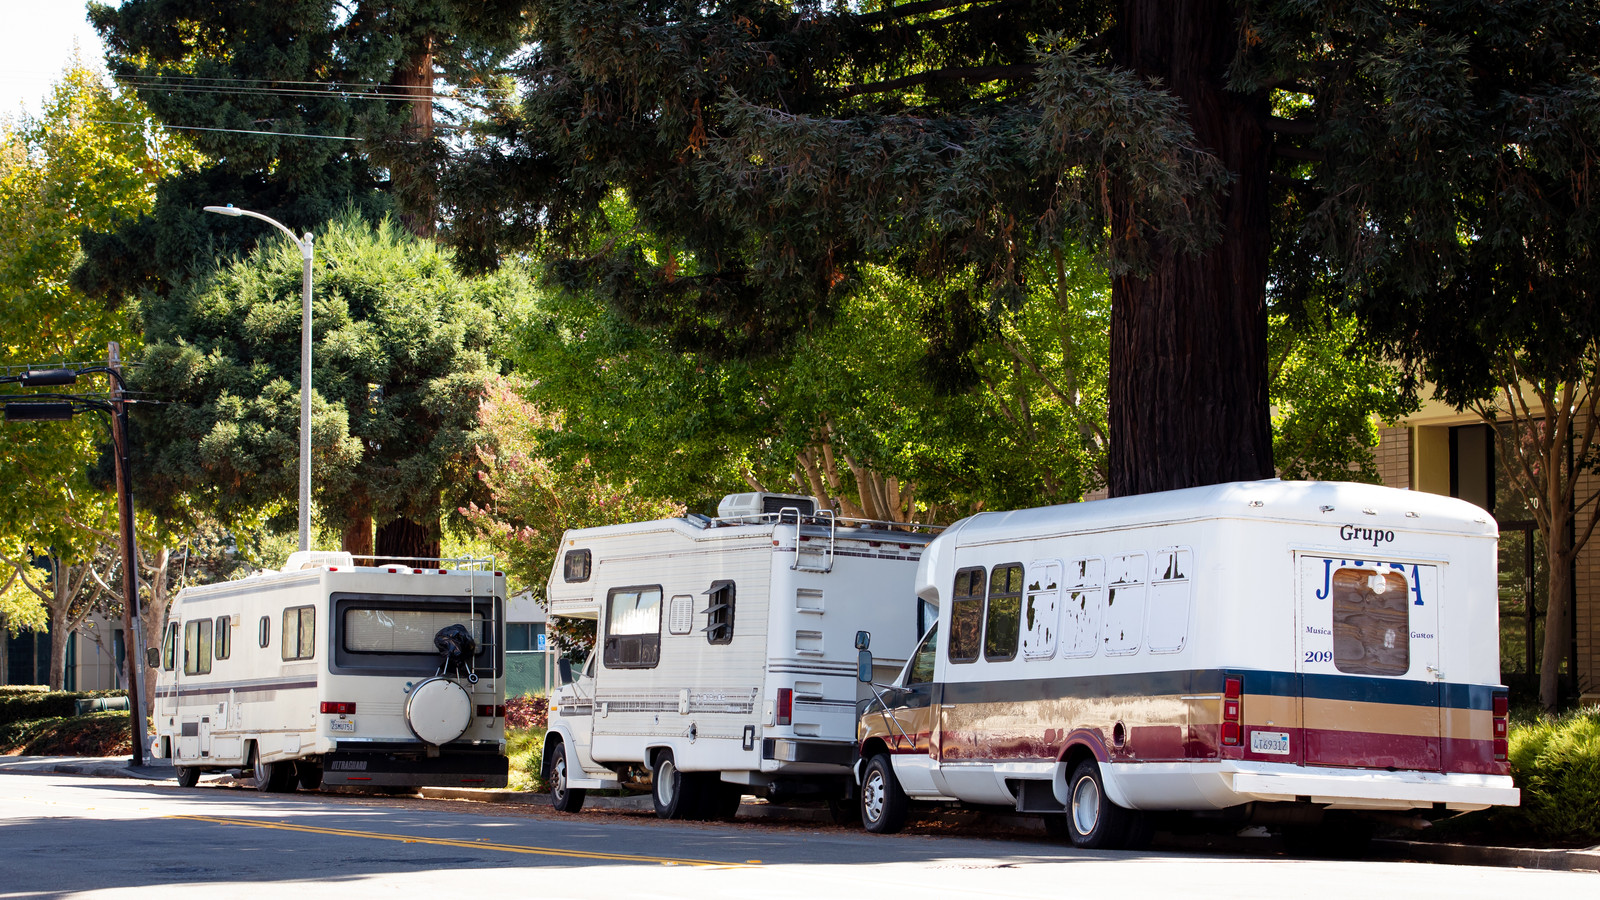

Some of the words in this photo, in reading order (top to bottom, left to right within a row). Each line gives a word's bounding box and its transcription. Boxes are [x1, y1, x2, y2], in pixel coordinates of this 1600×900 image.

[1340, 524, 1395, 547] Grupo
[1305, 626, 1332, 636] Musica
[1410, 631, 1434, 639] Gustos
[1304, 651, 1333, 662] 209
[331, 760, 368, 770] ULTRAGUARD
